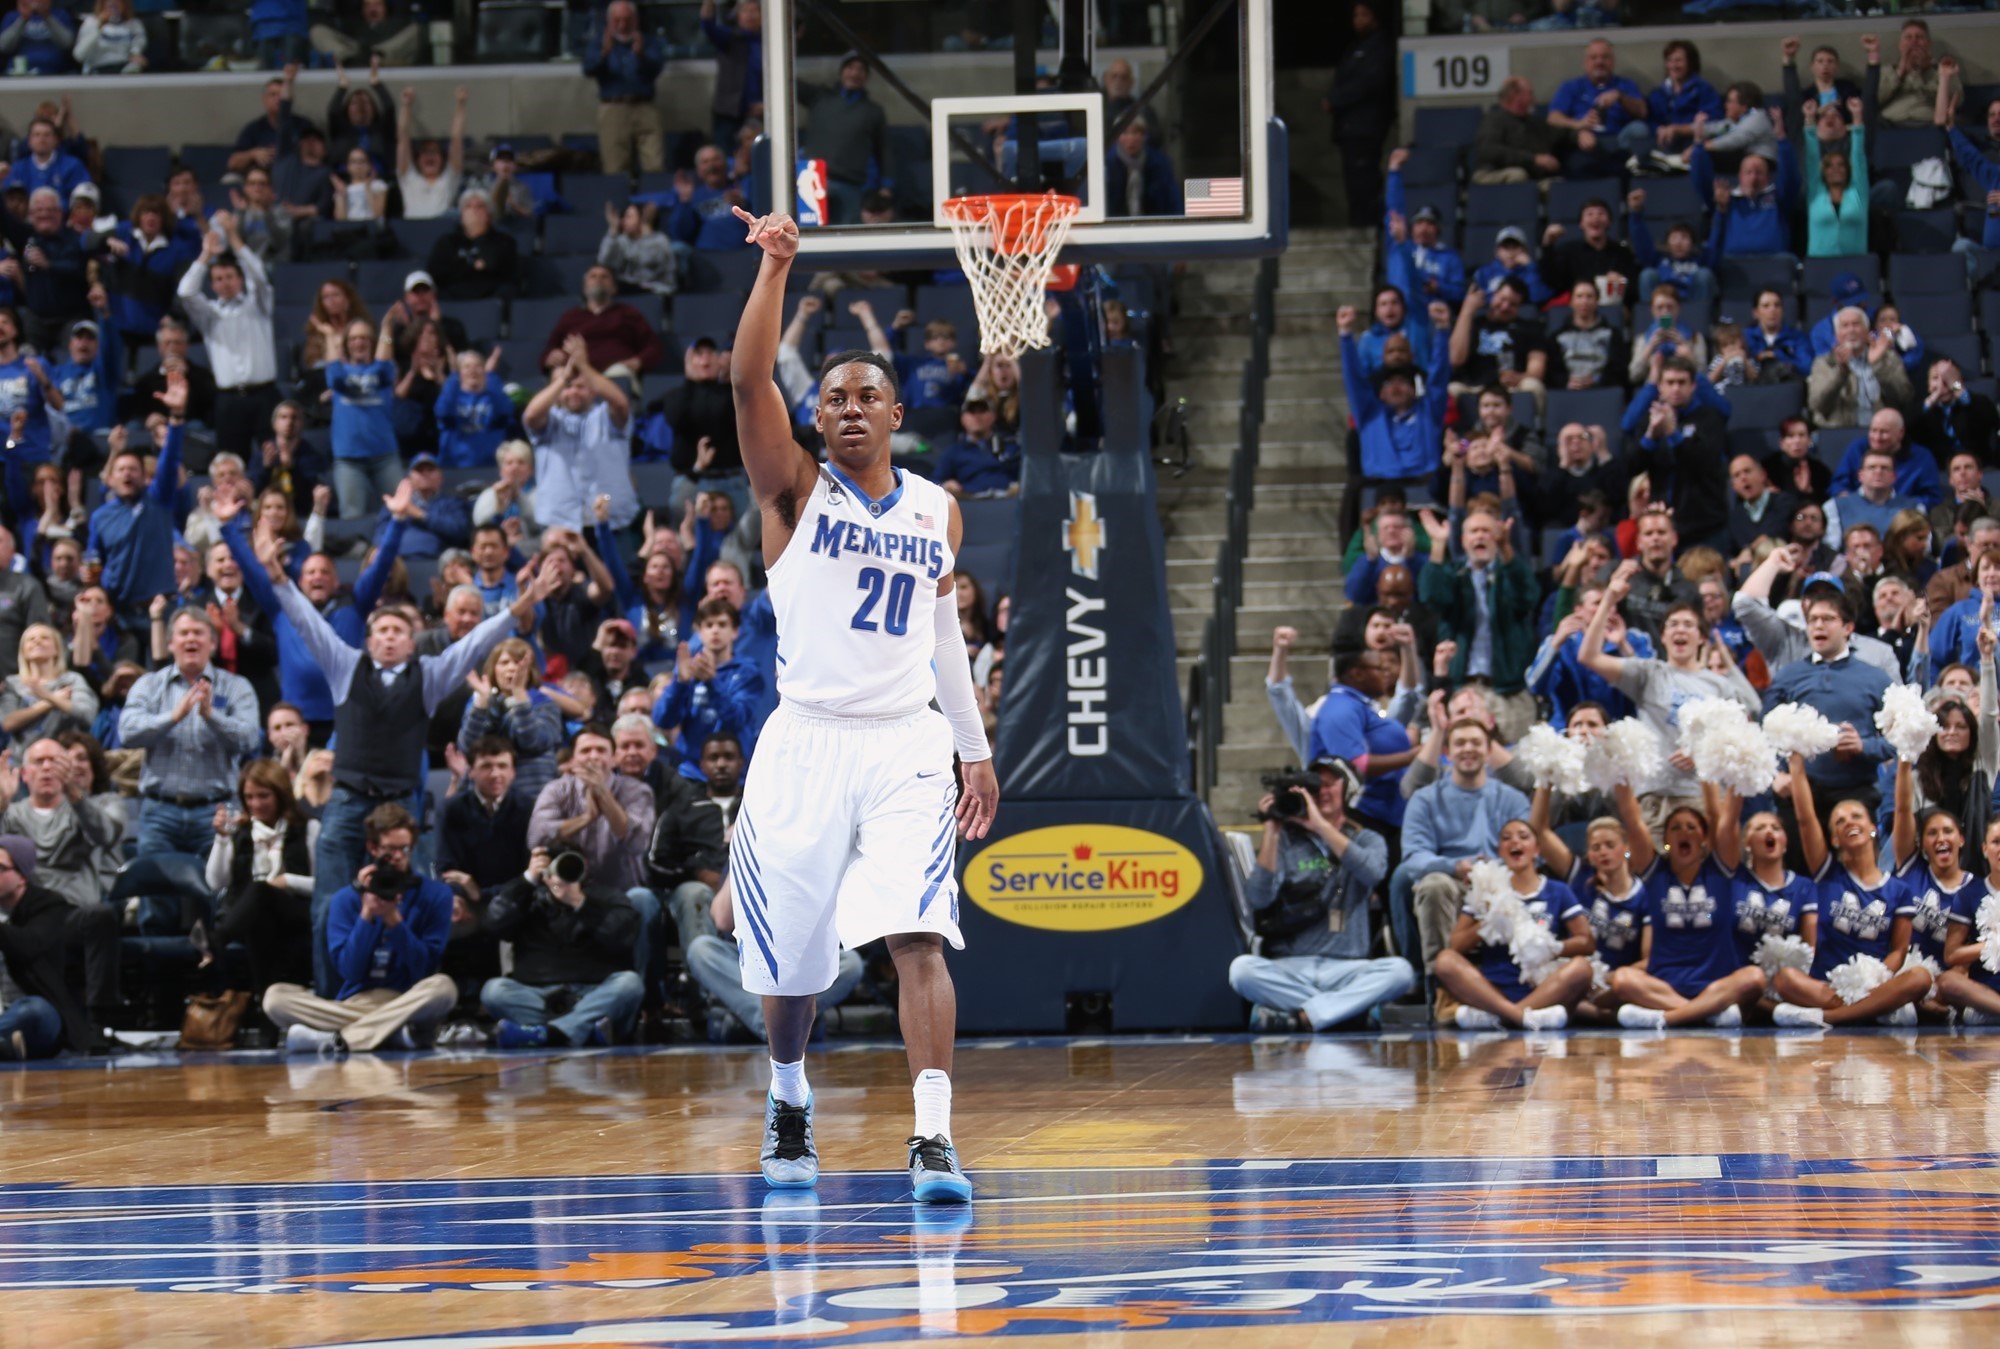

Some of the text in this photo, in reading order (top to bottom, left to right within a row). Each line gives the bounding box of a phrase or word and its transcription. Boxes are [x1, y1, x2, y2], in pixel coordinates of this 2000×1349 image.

[1433, 55, 1490, 88] 109
[810, 513, 944, 580] MEMPHIS
[850, 566, 916, 637] 20
[1066, 586, 1108, 756] CHEVY
